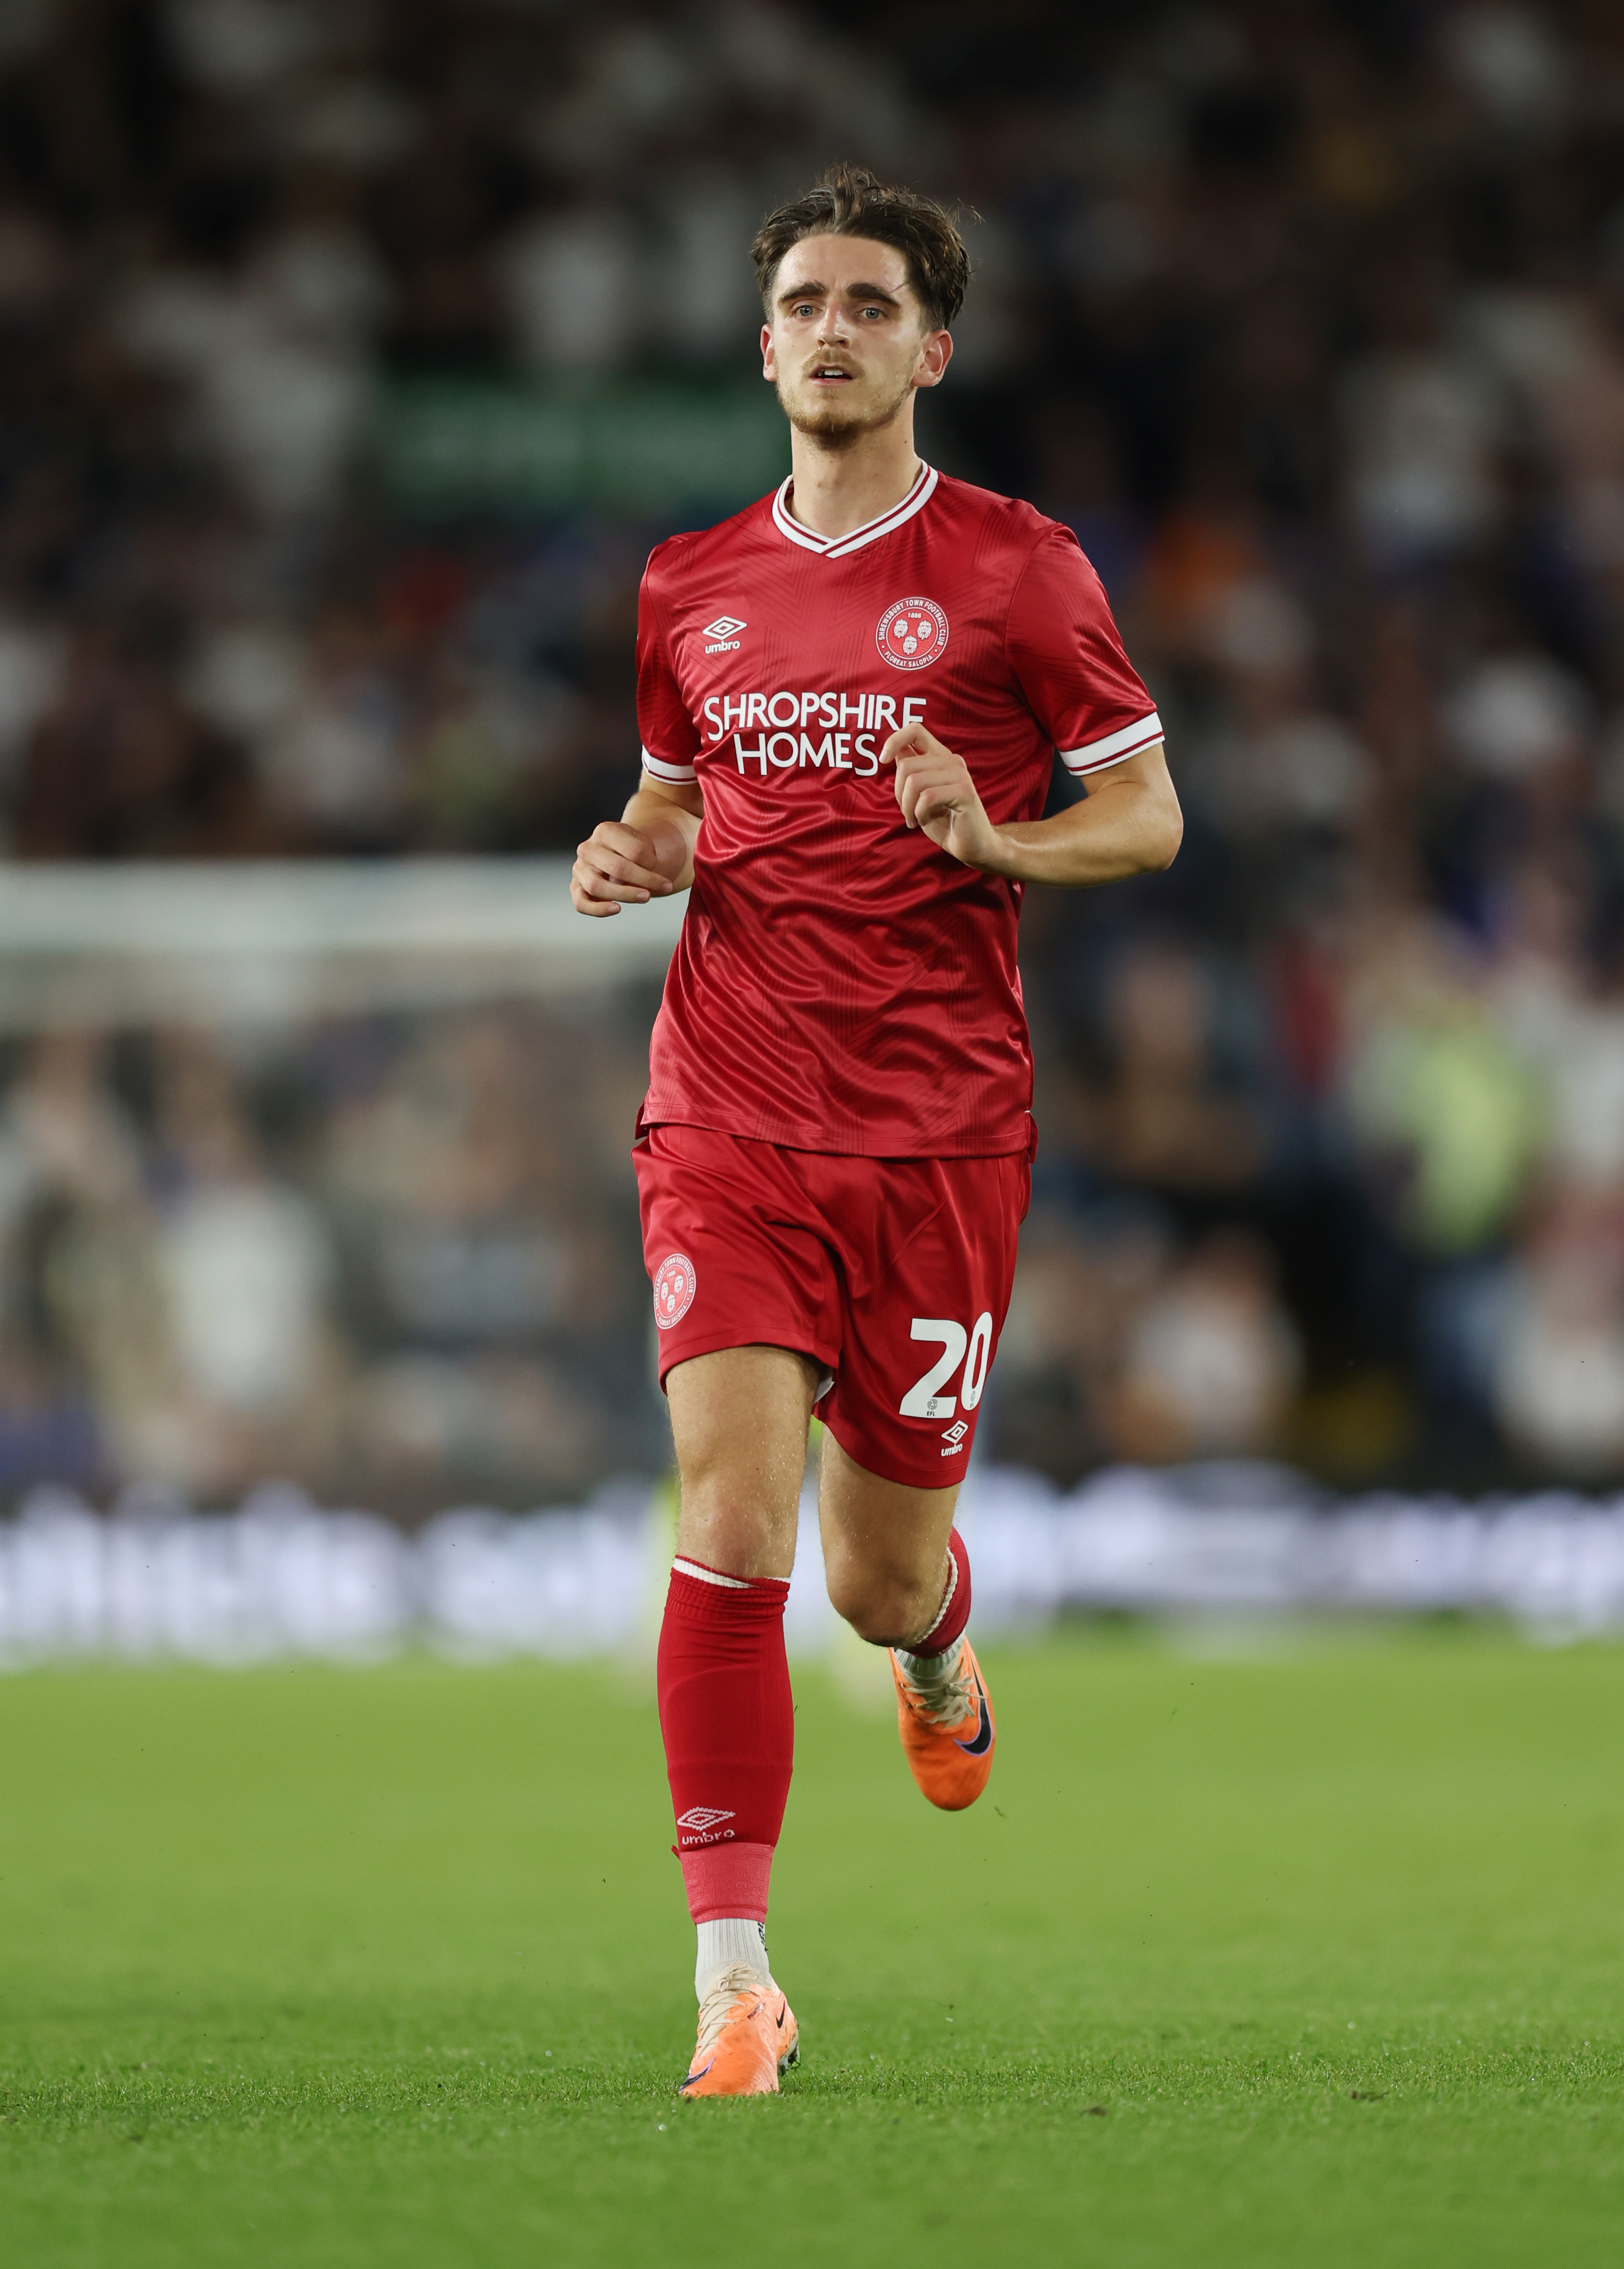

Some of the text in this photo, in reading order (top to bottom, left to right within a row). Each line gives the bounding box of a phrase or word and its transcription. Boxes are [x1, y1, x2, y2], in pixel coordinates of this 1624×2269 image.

[878, 603, 904, 641] SHREWSBURY
[924, 601, 945, 628] FOOTBALL
[937, 629, 946, 646] CLUB
[705, 640, 740, 654] umbro
[884, 651, 933, 667] FLOREAT SALOPIA
[704, 691, 927, 741] SHROPSHIRE
[733, 732, 879, 776] HOMES
[664, 1257, 676, 1268] TOWN
[676, 1256, 692, 1277] FOOTBALL
[672, 1305, 687, 1324] SALOPIA
[899, 1311, 993, 1419] 20
[941, 1443, 963, 1457] umbro
[682, 1829, 735, 1845] umbro
